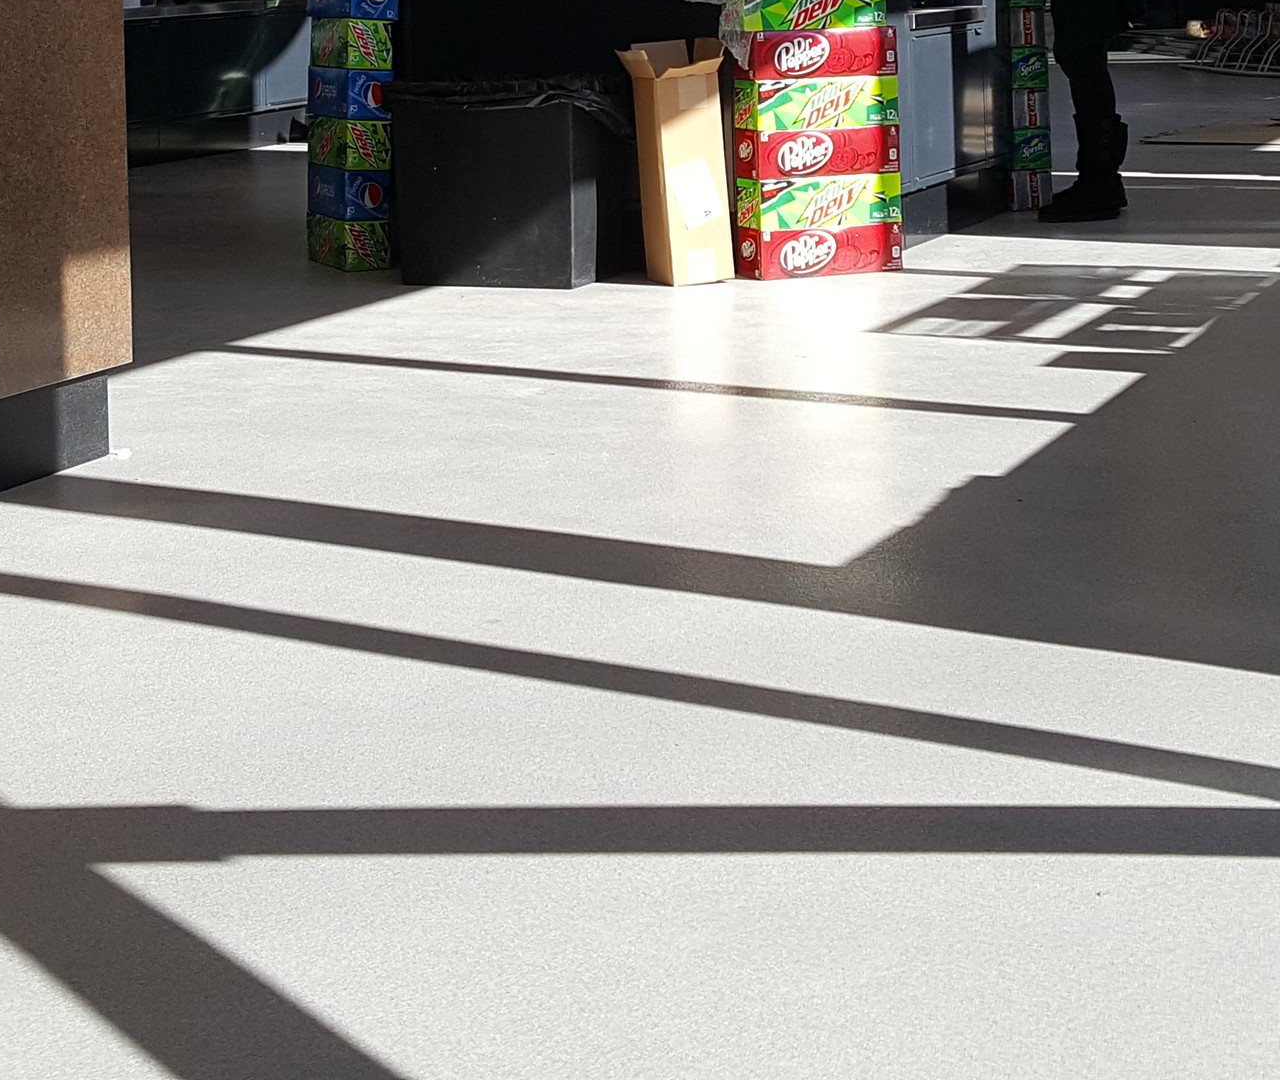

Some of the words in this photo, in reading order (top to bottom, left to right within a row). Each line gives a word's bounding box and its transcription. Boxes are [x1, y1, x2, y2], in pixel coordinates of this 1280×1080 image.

[386, 10, 394, 18] 12
[874, 12, 882, 21] 12
[794, 37, 812, 52] Dr
[782, 43, 826, 72] Pepper
[1020, 61, 1041, 76] Sprite
[886, 110, 894, 119] 12
[797, 136, 816, 151] Dr
[1022, 144, 1044, 158] Sprite
[784, 140, 829, 171] Pepper
[890, 206, 898, 216] 12
[800, 234, 819, 250] Dr
[787, 240, 832, 269] Pepper
